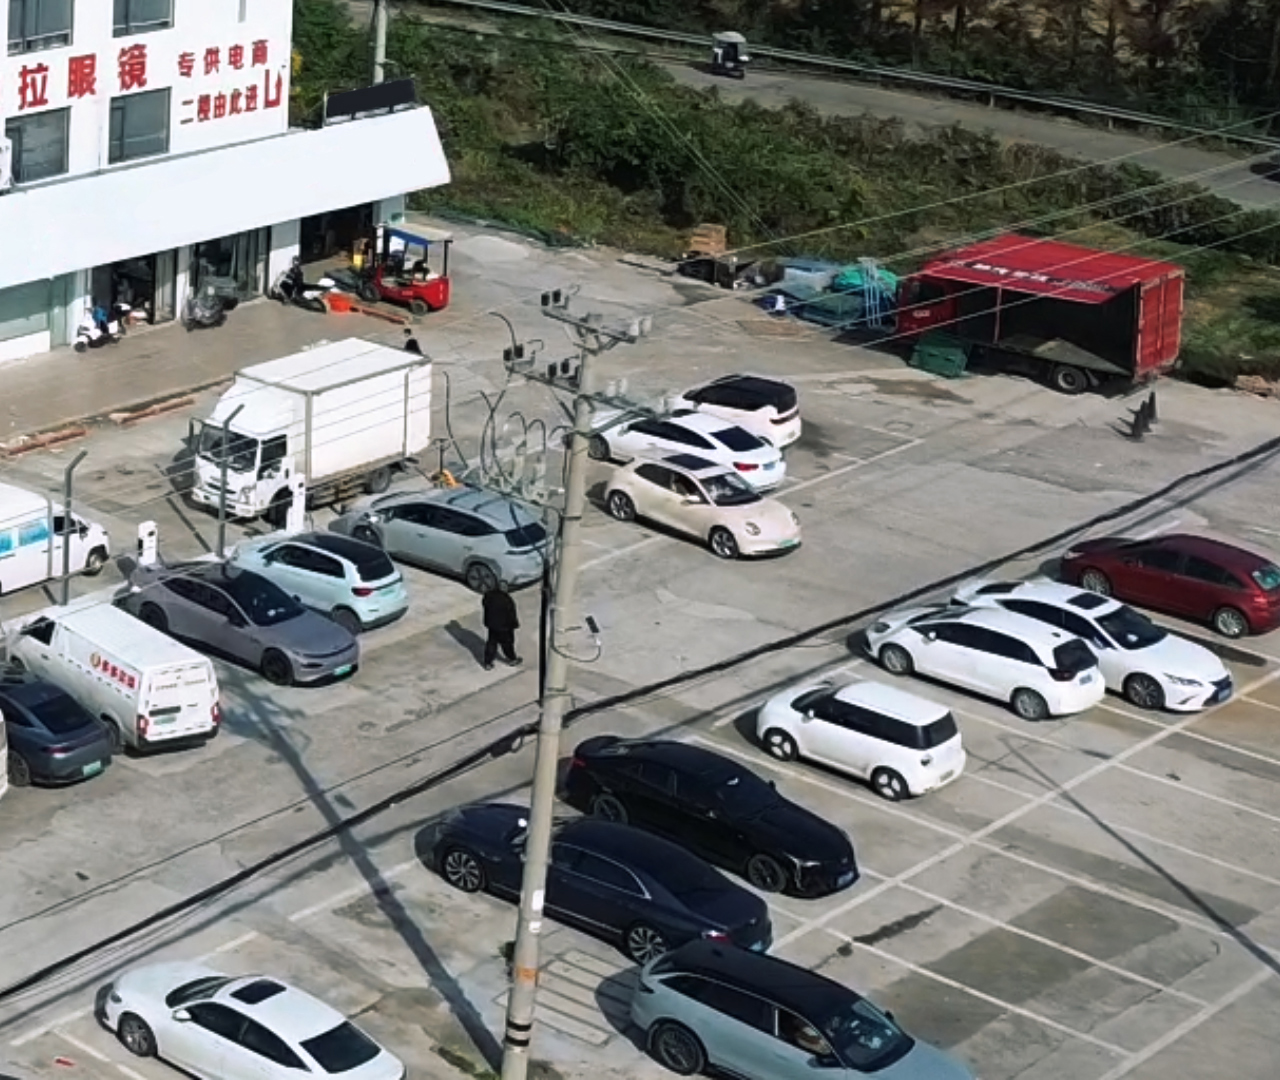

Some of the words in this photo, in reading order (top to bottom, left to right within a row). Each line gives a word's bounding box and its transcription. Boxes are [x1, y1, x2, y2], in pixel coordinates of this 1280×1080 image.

[177, 39, 268, 78] 专供电商
[180, 84, 258, 125] 二楼由此进
